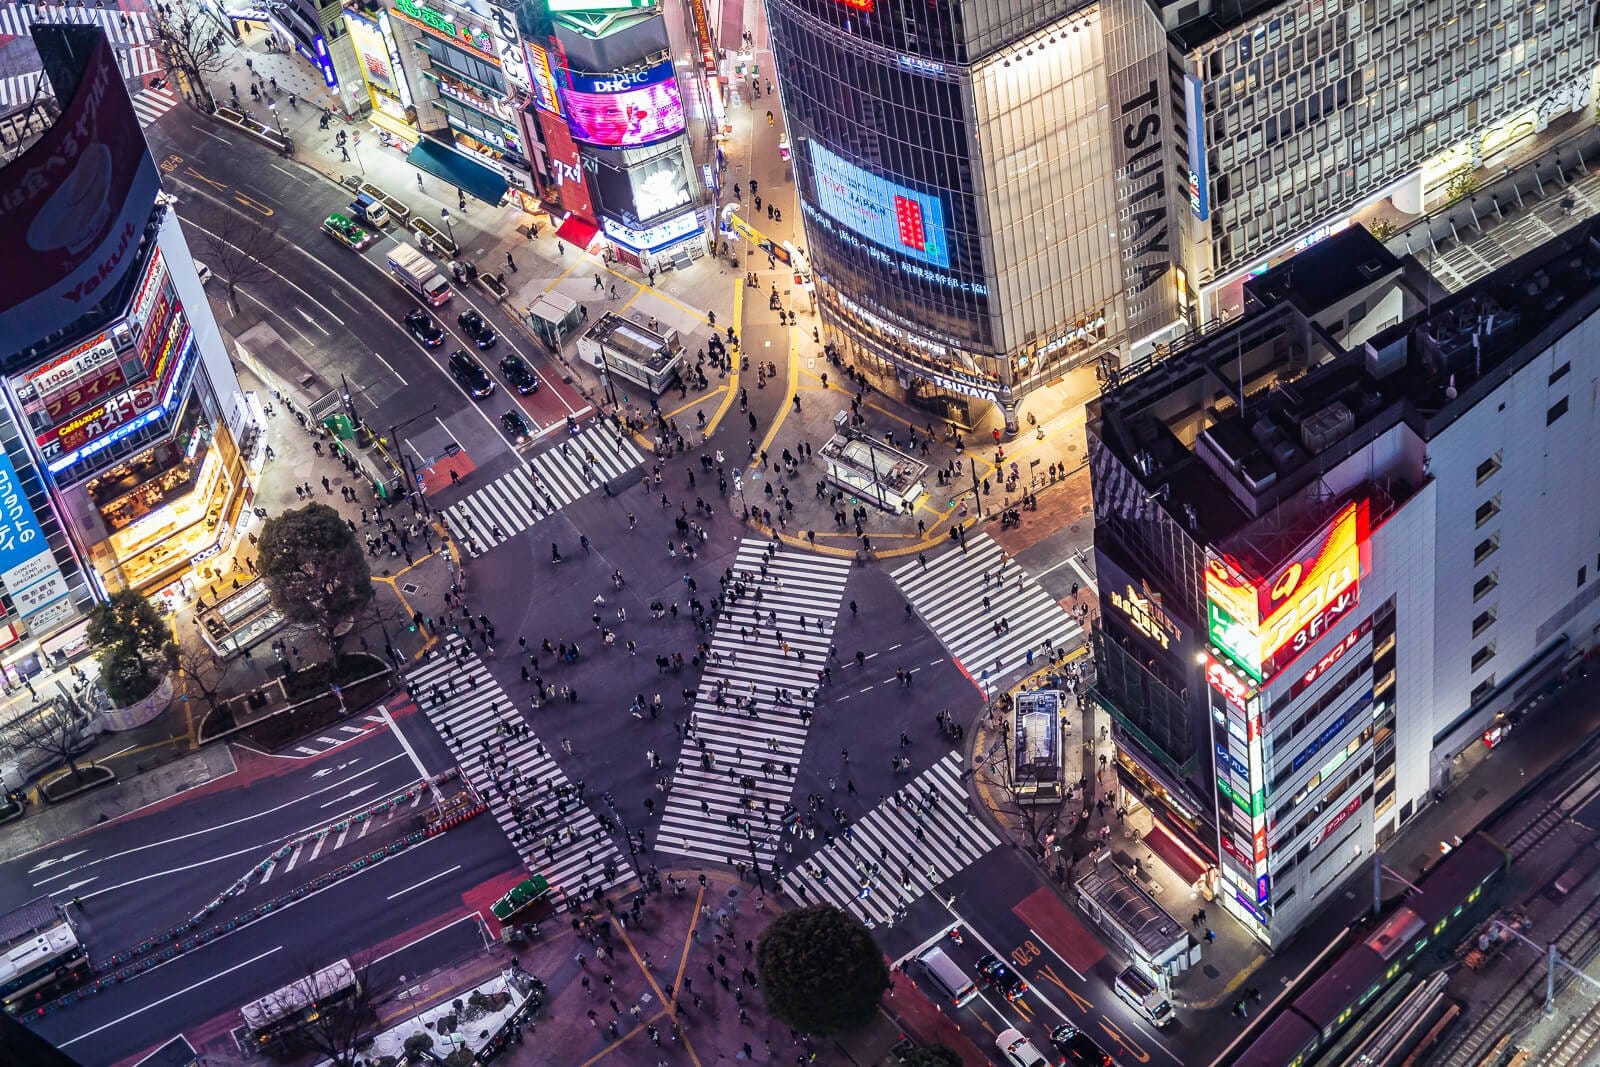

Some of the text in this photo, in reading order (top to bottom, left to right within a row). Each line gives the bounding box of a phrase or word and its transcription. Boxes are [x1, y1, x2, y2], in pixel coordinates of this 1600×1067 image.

[593, 80, 631, 92] DHC
[0, 63, 110, 216] は食べるヤクルト
[1121, 79, 1171, 299] TSUTAYA
[62, 222, 137, 304] Yakult
[1037, 316, 1107, 358] TSUTAYA
[18, 384, 35, 399] 9F
[934, 375, 998, 402] TSUTAYA
[951, 370, 1011, 394] TSUTAYA
[103, 387, 143, 414] ガスト
[85, 406, 131, 437] ガスト
[43, 442, 61, 457] 7F
[12, 564, 52, 587] SPECIALISTS
[13, 558, 42, 577] CONTACT
[22, 566, 38, 578] LENS
[1264, 566, 1351, 658] アコム
[1293, 612, 1324, 652] 3F
[1319, 630, 1358, 671] アイフル
[1011, 939, 1041, 968] 8-20
